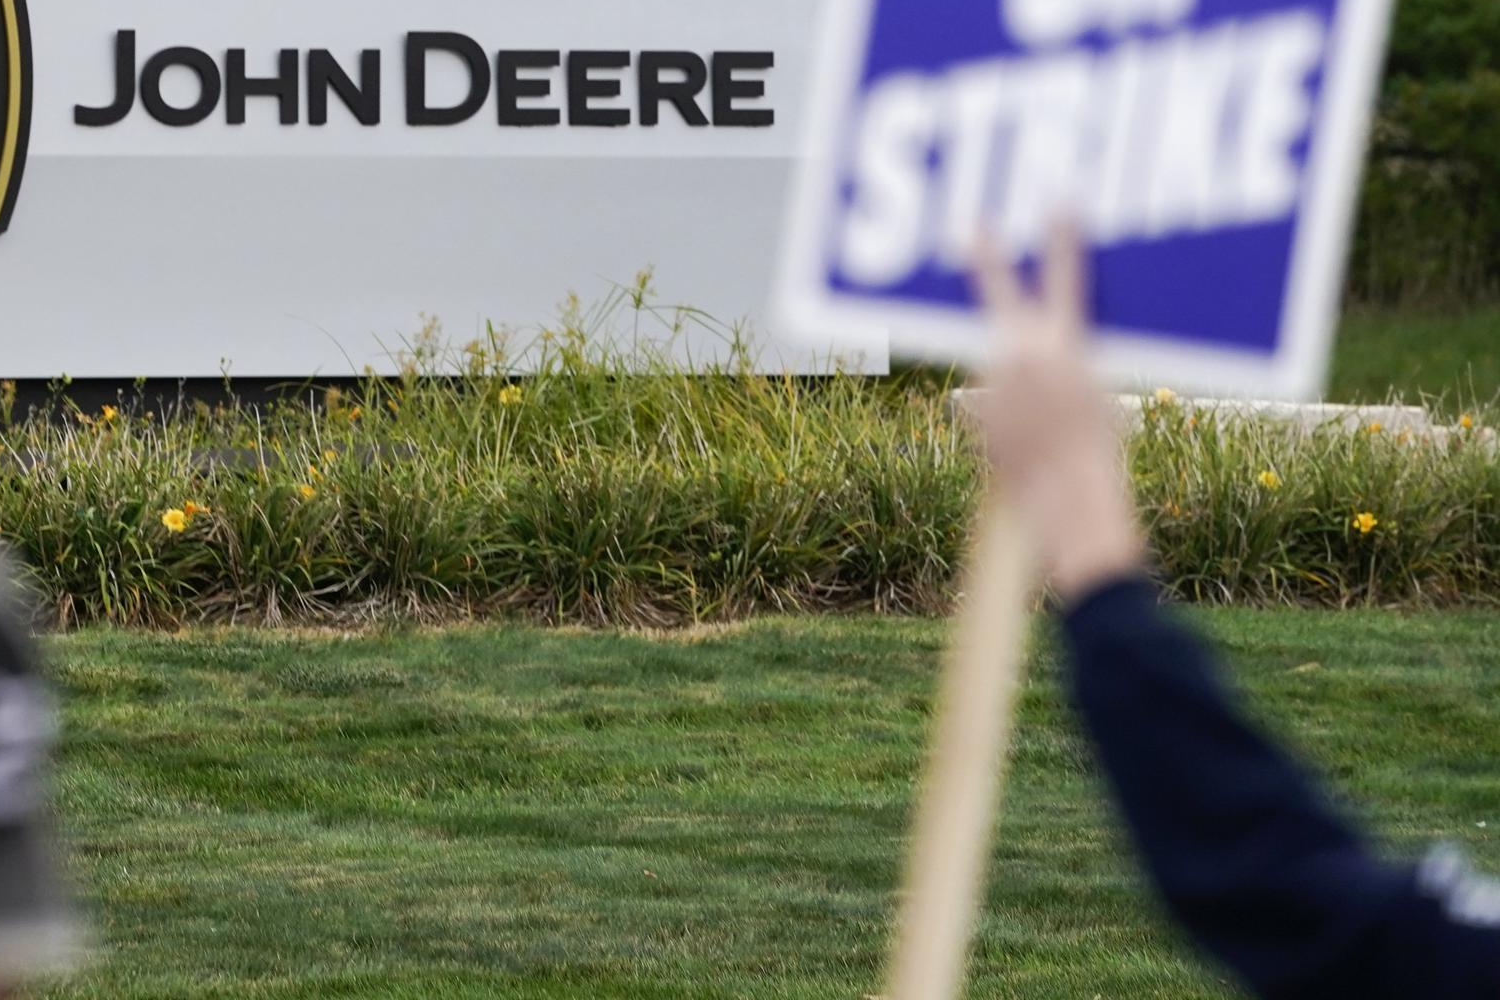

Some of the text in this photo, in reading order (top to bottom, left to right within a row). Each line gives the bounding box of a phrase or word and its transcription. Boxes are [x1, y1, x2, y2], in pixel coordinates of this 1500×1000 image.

[73, 28, 777, 129] JOHN DEERE
[836, 8, 1326, 290] STRIKE
